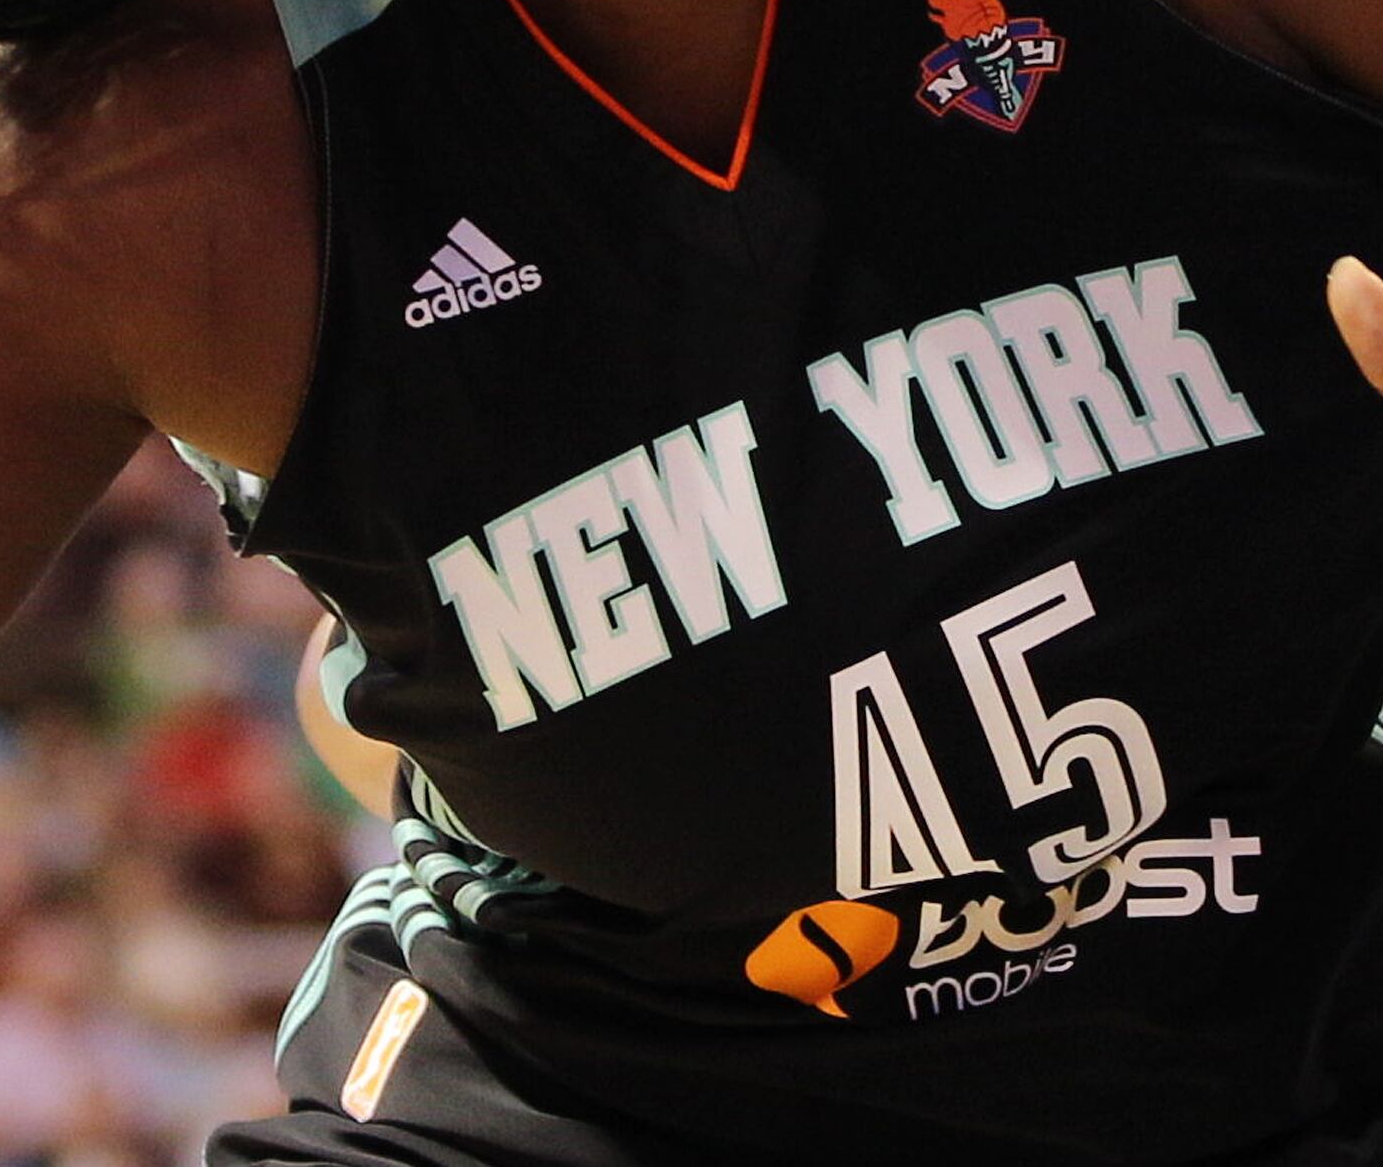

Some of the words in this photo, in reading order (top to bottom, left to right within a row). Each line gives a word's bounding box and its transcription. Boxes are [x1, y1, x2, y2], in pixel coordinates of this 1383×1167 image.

[404, 264, 543, 328] adidas
[427, 400, 787, 732] NEW
[806, 255, 1265, 546] YORK
[829, 560, 1167, 900] 45
[904, 942, 1078, 1021] mobile
